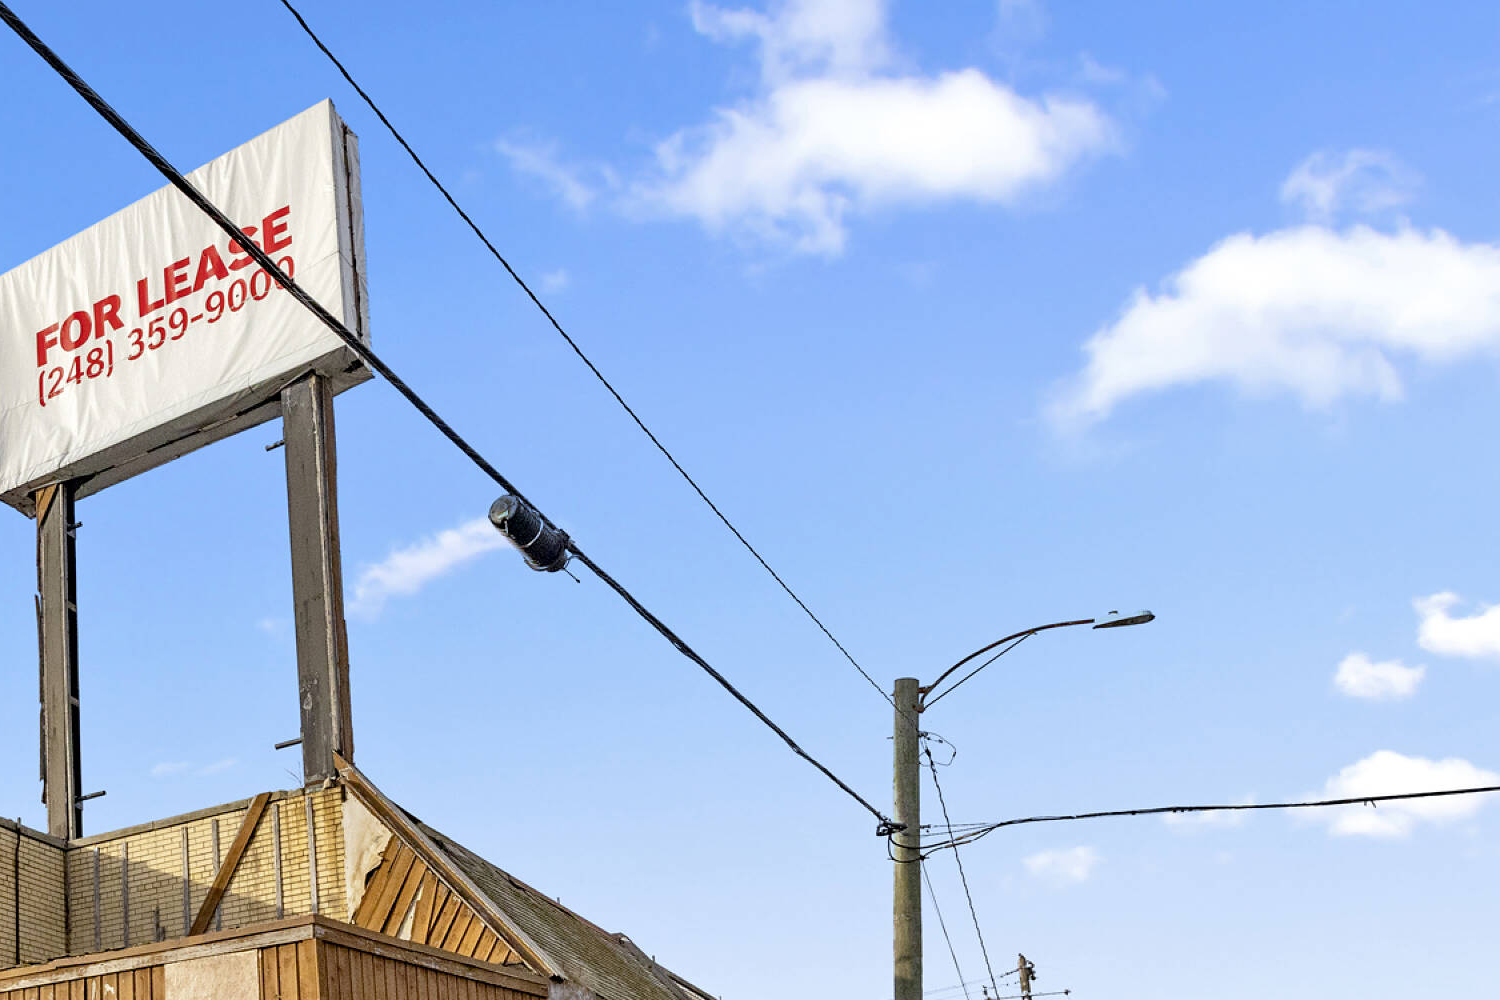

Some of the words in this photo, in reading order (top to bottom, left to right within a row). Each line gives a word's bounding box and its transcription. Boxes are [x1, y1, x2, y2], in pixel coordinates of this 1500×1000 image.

[36, 294, 124, 367] FOR
[137, 205, 292, 317] LEASE
[39, 340, 113, 407] (248)
[127, 255, 294, 361] 359-9000
